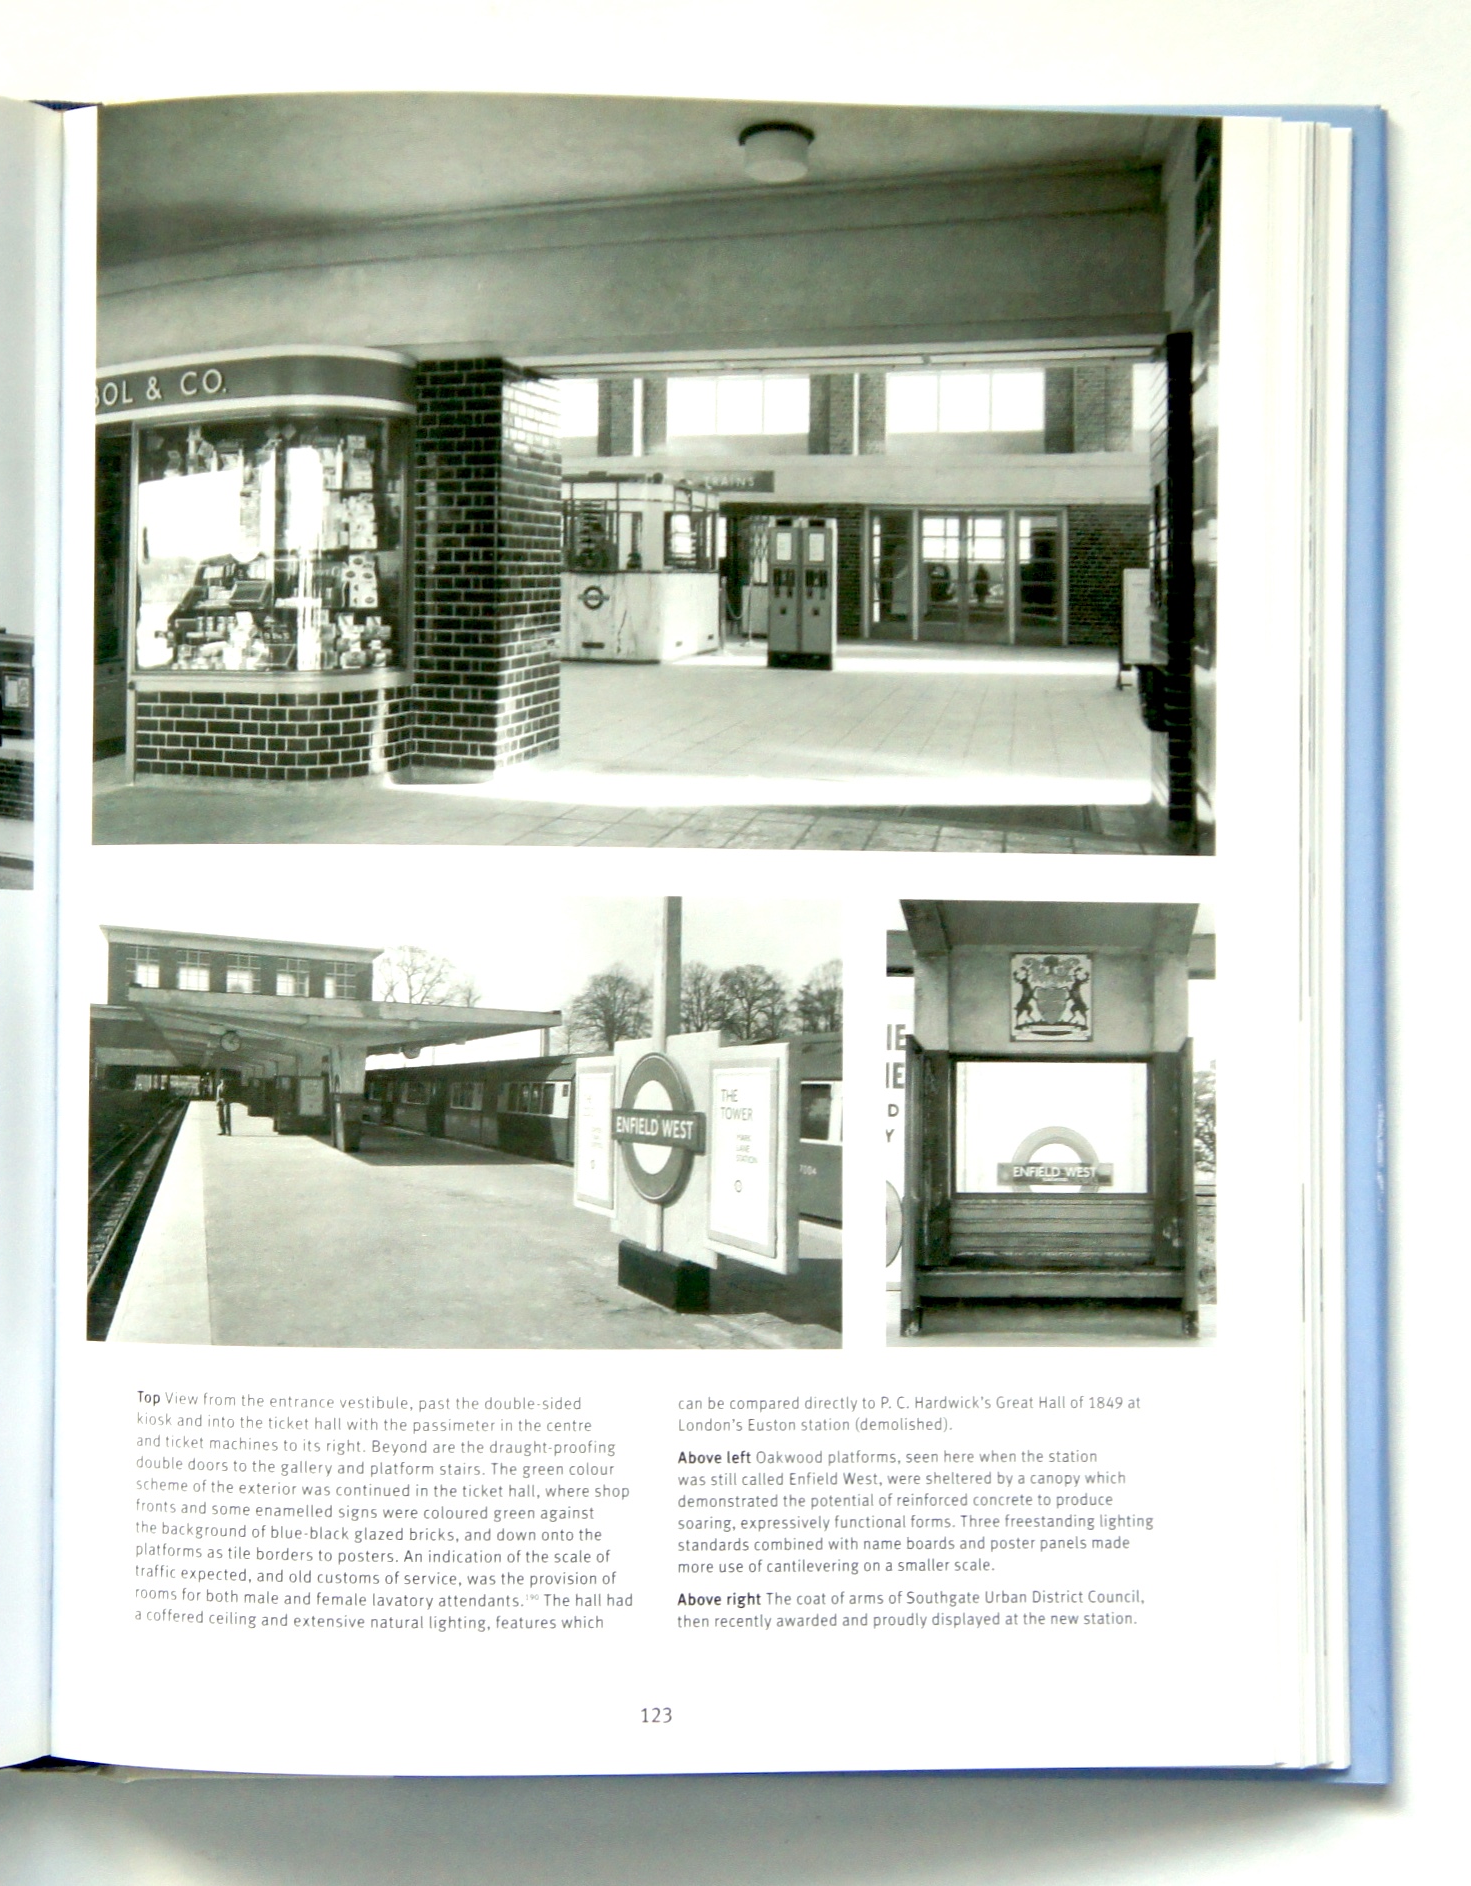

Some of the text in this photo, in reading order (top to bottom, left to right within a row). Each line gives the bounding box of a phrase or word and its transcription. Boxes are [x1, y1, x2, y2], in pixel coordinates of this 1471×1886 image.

[146, 375, 161, 400] &
[180, 368, 227, 396] CO.
[720, 1088, 739, 1103] THE
[720, 1106, 754, 1122] TOWER
[616, 1115, 694, 1140] ENFIELD WEST
[1013, 1166, 1097, 1178] ENFIELD WEST
[136, 1390, 582, 1413] Top View from the entrance vestibule, past the double-sided
[677, 1449, 1098, 1467] Above left Oakwood platforms, seen here when the station
[135, 1520, 603, 1544] the background of blue-black glazed bricks, and down onto the
[676, 1589, 1145, 1609] Above right The coat of arms of Southgate Urban District Council,
[134, 1608, 604, 1633] a coffered ceiling and extensive natural lighting, features which
[640, 1707, 673, 1724] 123
